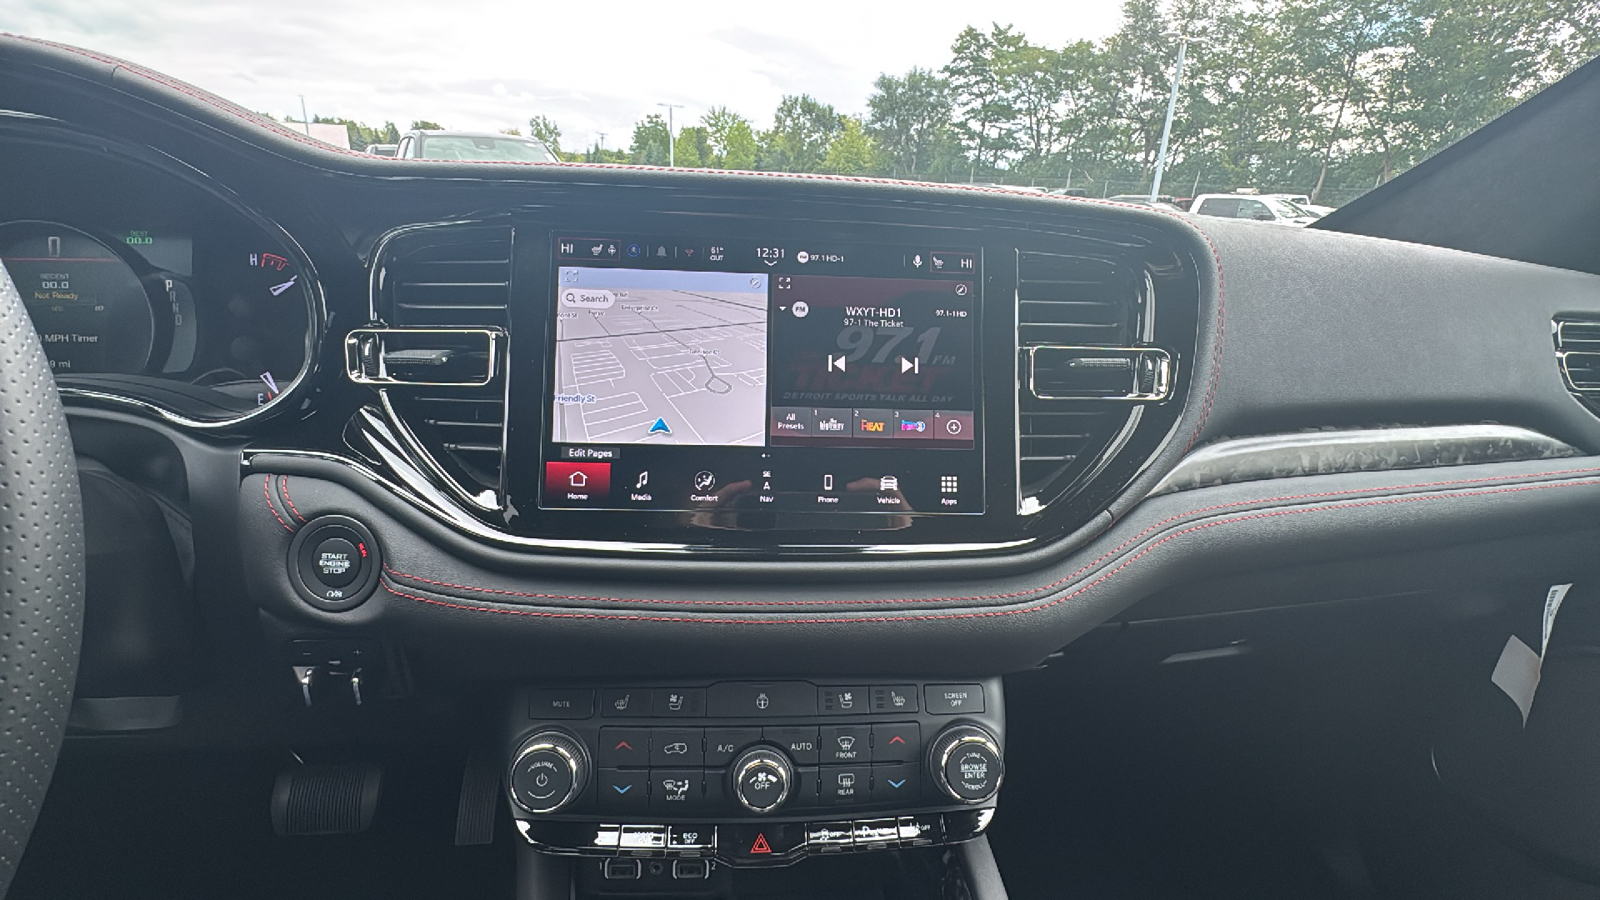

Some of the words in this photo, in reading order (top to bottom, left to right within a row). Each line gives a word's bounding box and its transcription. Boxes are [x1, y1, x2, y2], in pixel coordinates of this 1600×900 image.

[126, 236, 152, 244] 00.0
[561, 243, 574, 254] HI
[756, 247, 785, 259] 12:31
[250, 253, 258, 266] H
[961, 258, 973, 269] HI
[42, 281, 69, 289] 00.0
[165, 279, 173, 292] P
[34, 291, 50, 299] Not
[52, 291, 79, 301] Ready
[170, 291, 176, 302] R
[580, 293, 609, 303] Search
[846, 306, 902, 318] WXYT-HD1
[175, 314, 182, 326] D
[843, 318, 862, 326] 97-1
[864, 319, 879, 327] The
[880, 319, 904, 328] Ticket
[45, 334, 69, 342] MPH
[71, 334, 98, 343] Timer
[58, 359, 71, 368] mi
[932, 355, 956, 365] FM
[257, 393, 264, 406] E
[587, 395, 595, 403] St
[834, 392, 878, 401] SPORTS
[879, 394, 906, 402] TALK
[931, 395, 954, 403] DAY
[786, 413, 796, 421] All
[778, 422, 805, 431] Presets
[861, 421, 885, 432] HEAT
[569, 448, 586, 457] Edit
[588, 449, 613, 459] Pages
[631, 493, 652, 501] Media
[691, 494, 718, 502] Comfort
[760, 495, 774, 503] Nav
[818, 496, 839, 504] Phone
[877, 496, 901, 504] Vehicle
[941, 498, 957, 506] Apps
[321, 552, 348, 560] START
[319, 560, 350, 568] ENGINE
[552, 700, 570, 708] MUTE
[950, 699, 962, 707] OFF
[717, 743, 734, 753] A/C
[790, 742, 812, 751] AUTO
[835, 751, 857, 759] FRONT
[960, 763, 987, 771] BROWSE
[754, 781, 770, 790] OFF
[837, 788, 854, 796] REAR
